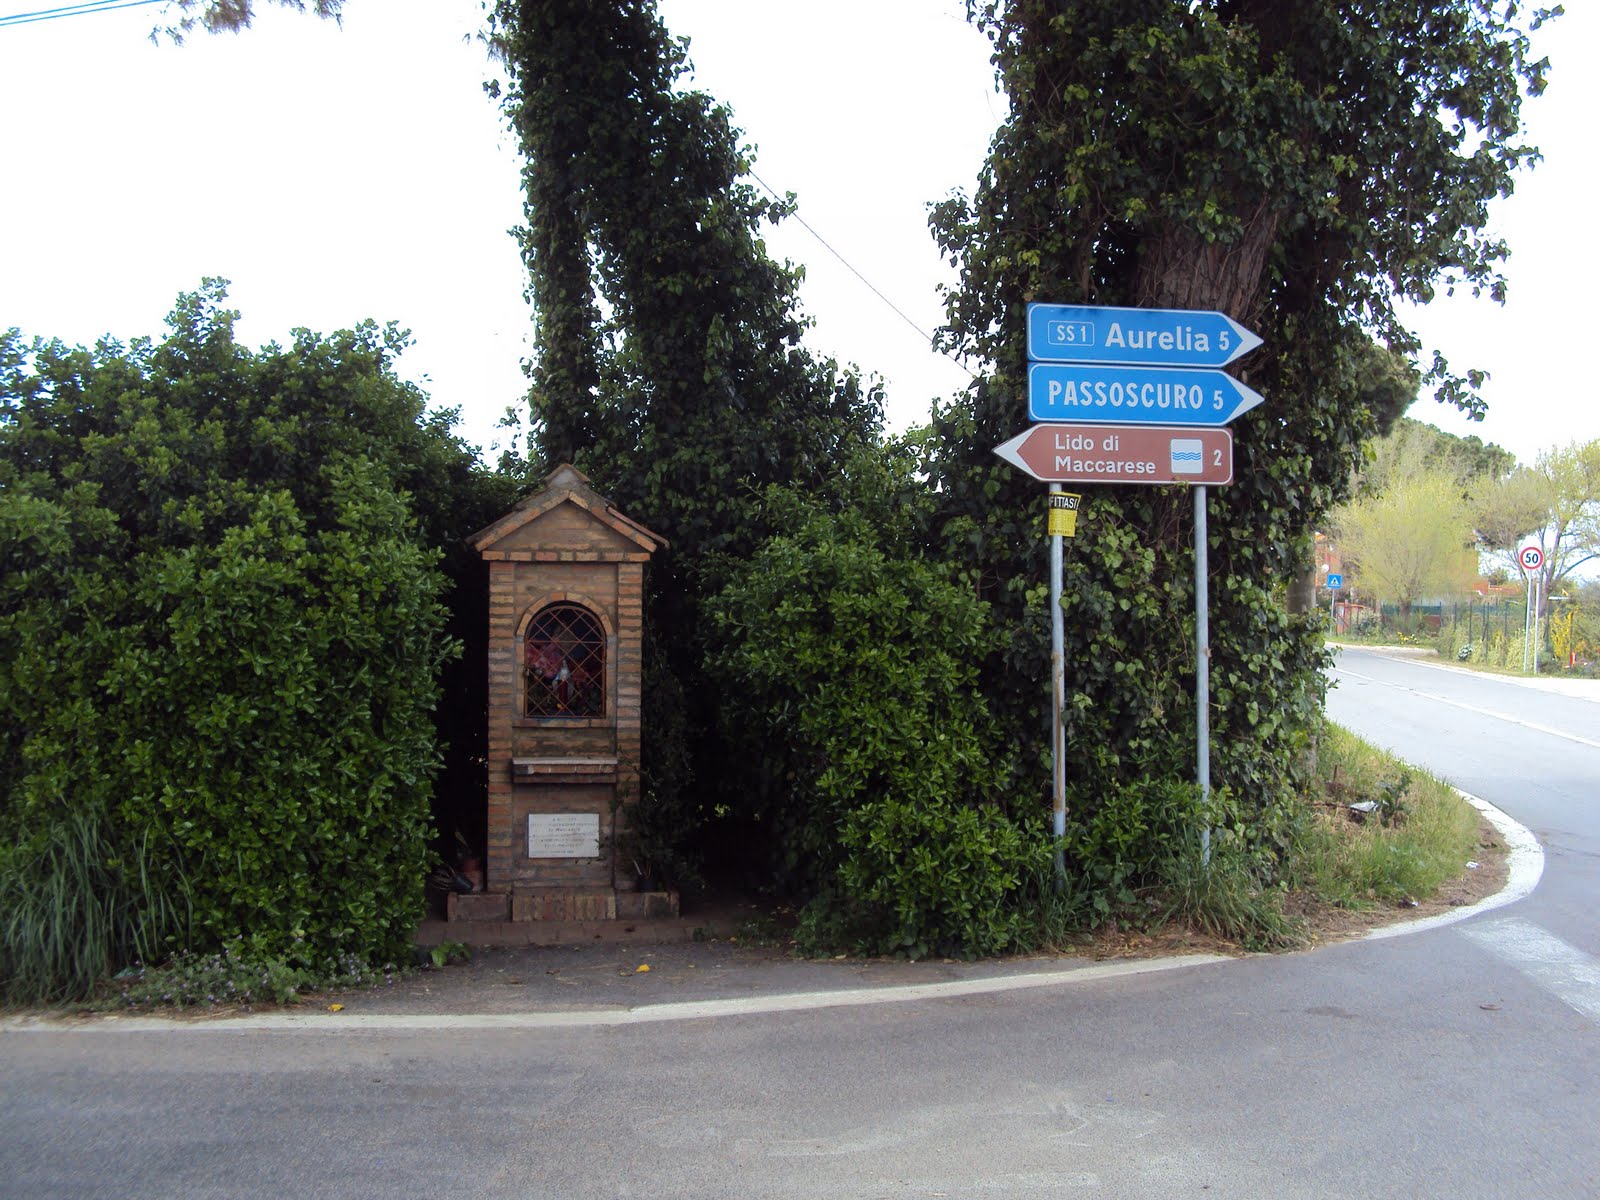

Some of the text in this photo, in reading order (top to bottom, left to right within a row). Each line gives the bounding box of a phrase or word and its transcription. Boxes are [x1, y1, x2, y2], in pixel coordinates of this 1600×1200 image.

[1056, 323, 1230, 352] SS 1 Aurelia 5
[1048, 380, 1224, 410] PASSOSCURO 5
[1055, 434, 1119, 451] Lido di
[1055, 456, 1156, 474] Maccarese
[1213, 449, 1222, 466] 2
[1525, 553, 1539, 564] 50
